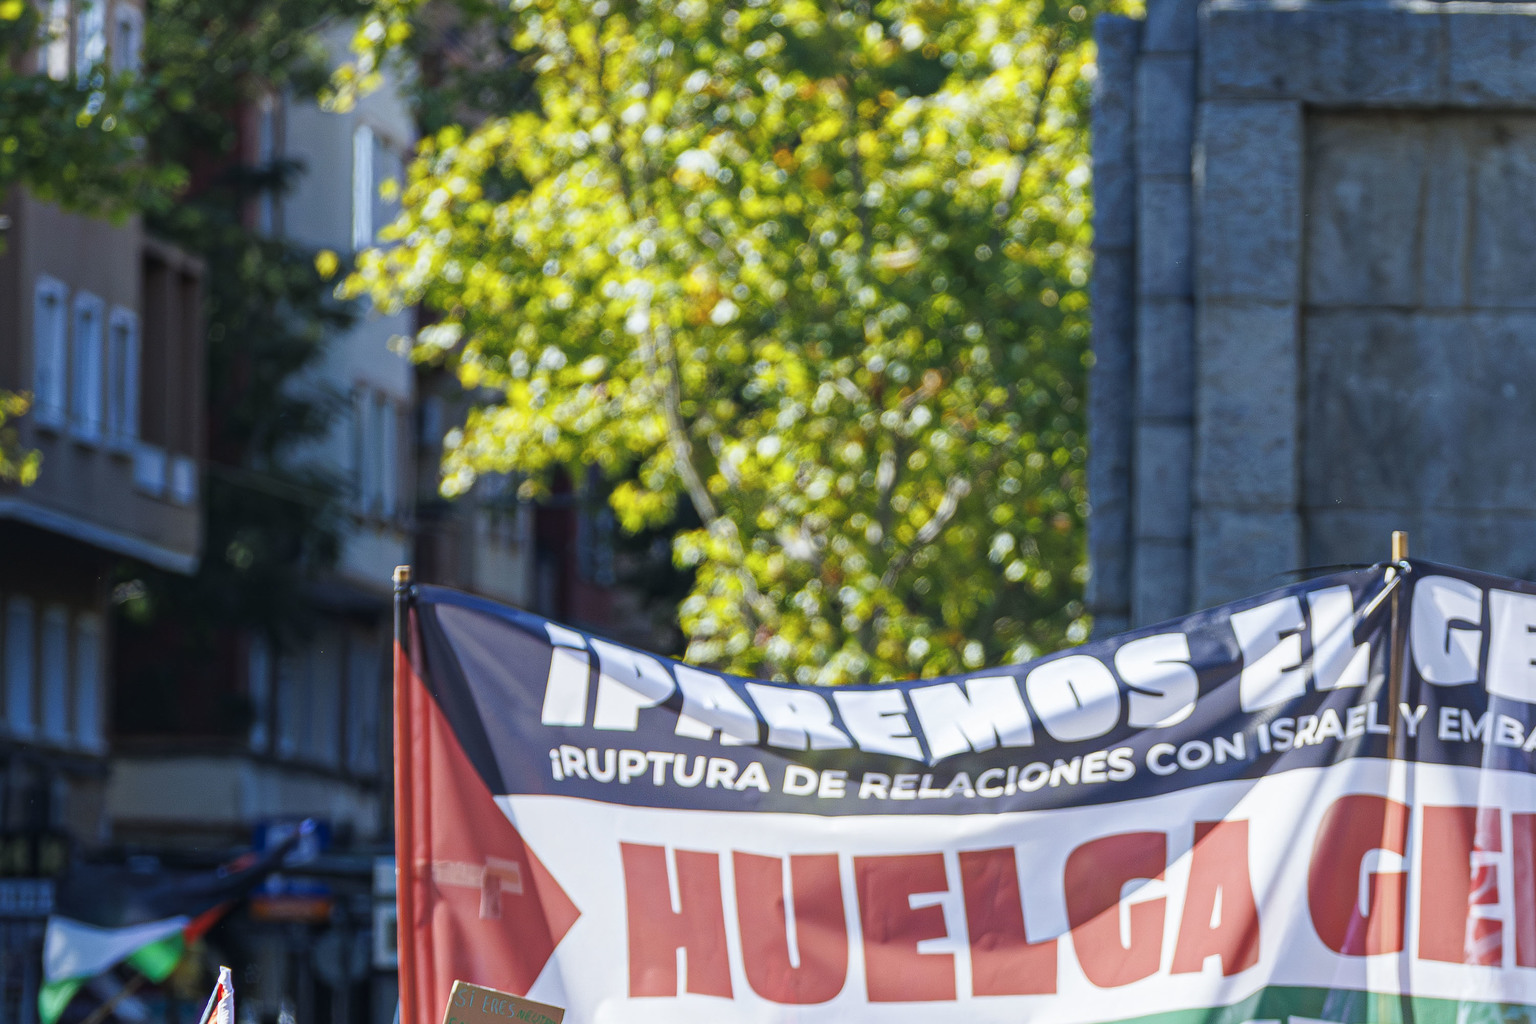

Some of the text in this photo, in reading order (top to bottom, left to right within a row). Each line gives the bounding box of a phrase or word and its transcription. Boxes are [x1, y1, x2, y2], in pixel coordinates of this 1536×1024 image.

[1230, 584, 1372, 713] EL
[782, 764, 849, 800] DE
[858, 749, 1138, 801] RELACIONES
[1146, 730, 1247, 786] CON
[1257, 701, 1391, 749] ISRAEL
[1399, 702, 1429, 738] Y
[619, 818, 1260, 1005] HUELGA
[482, 995, 516, 1019] ERES
